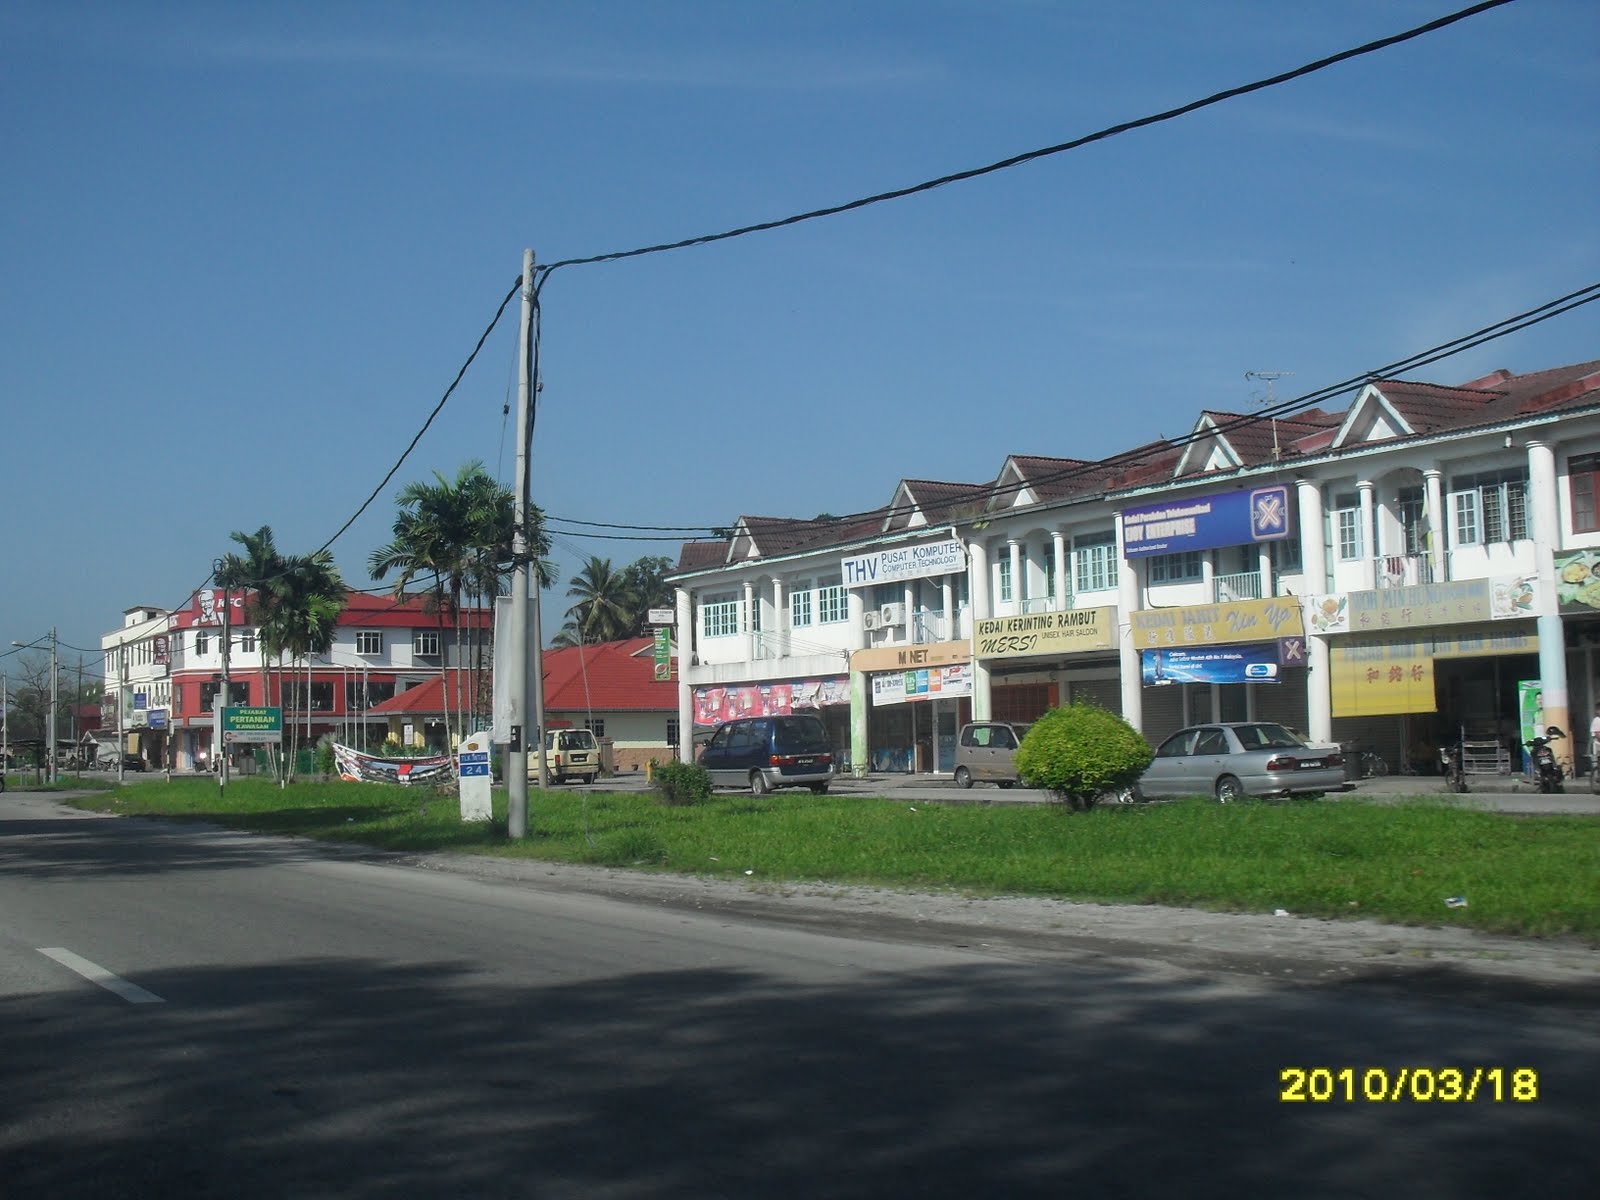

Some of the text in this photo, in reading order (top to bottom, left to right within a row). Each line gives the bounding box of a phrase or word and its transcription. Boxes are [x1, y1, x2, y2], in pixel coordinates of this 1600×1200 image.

[881, 551, 908, 564] PUSAT
[882, 560, 917, 573] COMPUTER
[918, 555, 957, 568] TECHNOLOGY
[844, 558, 877, 583] THV
[978, 611, 1096, 635] KEDAI KERINTING RAMBUT
[1042, 630, 1060, 639] UNISEX
[1062, 628, 1075, 638] HAIR
[980, 634, 1038, 653] MERSI
[909, 649, 928, 664] NET
